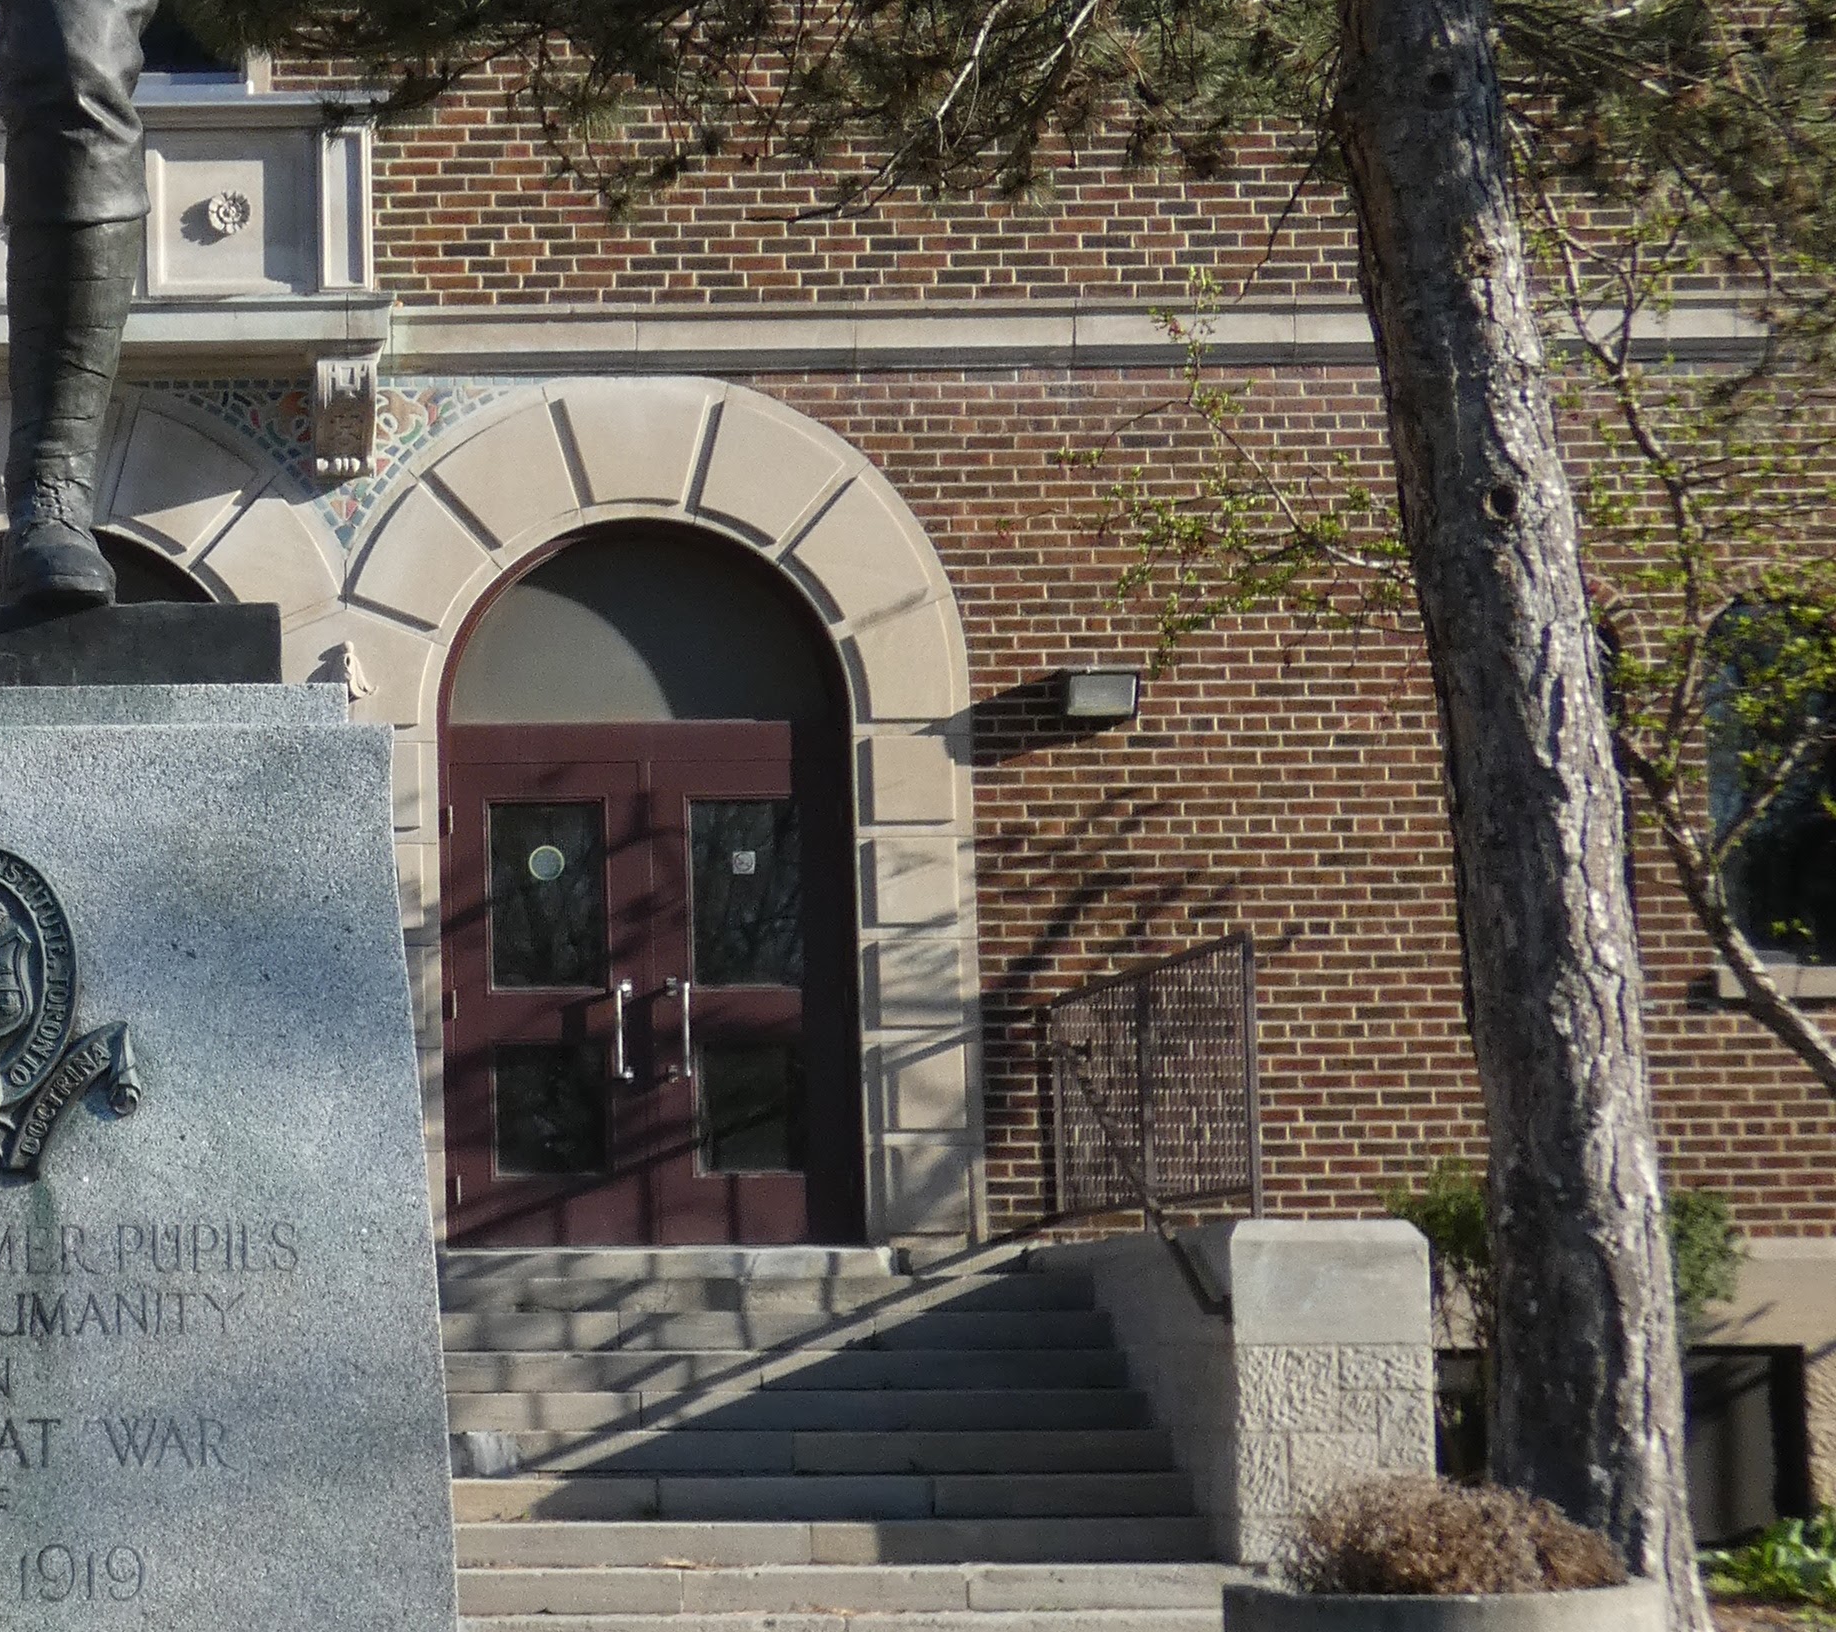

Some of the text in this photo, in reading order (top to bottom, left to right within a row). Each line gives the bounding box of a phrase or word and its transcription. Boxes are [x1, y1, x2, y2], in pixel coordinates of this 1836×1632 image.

[10, 970, 68, 1086] TORONTO
[20, 1040, 112, 1156] DOCTRINA
[117, 1221, 299, 1274] PUPILS
[99, 1416, 242, 1469] WAR
[19, 1543, 147, 1604] 1919
